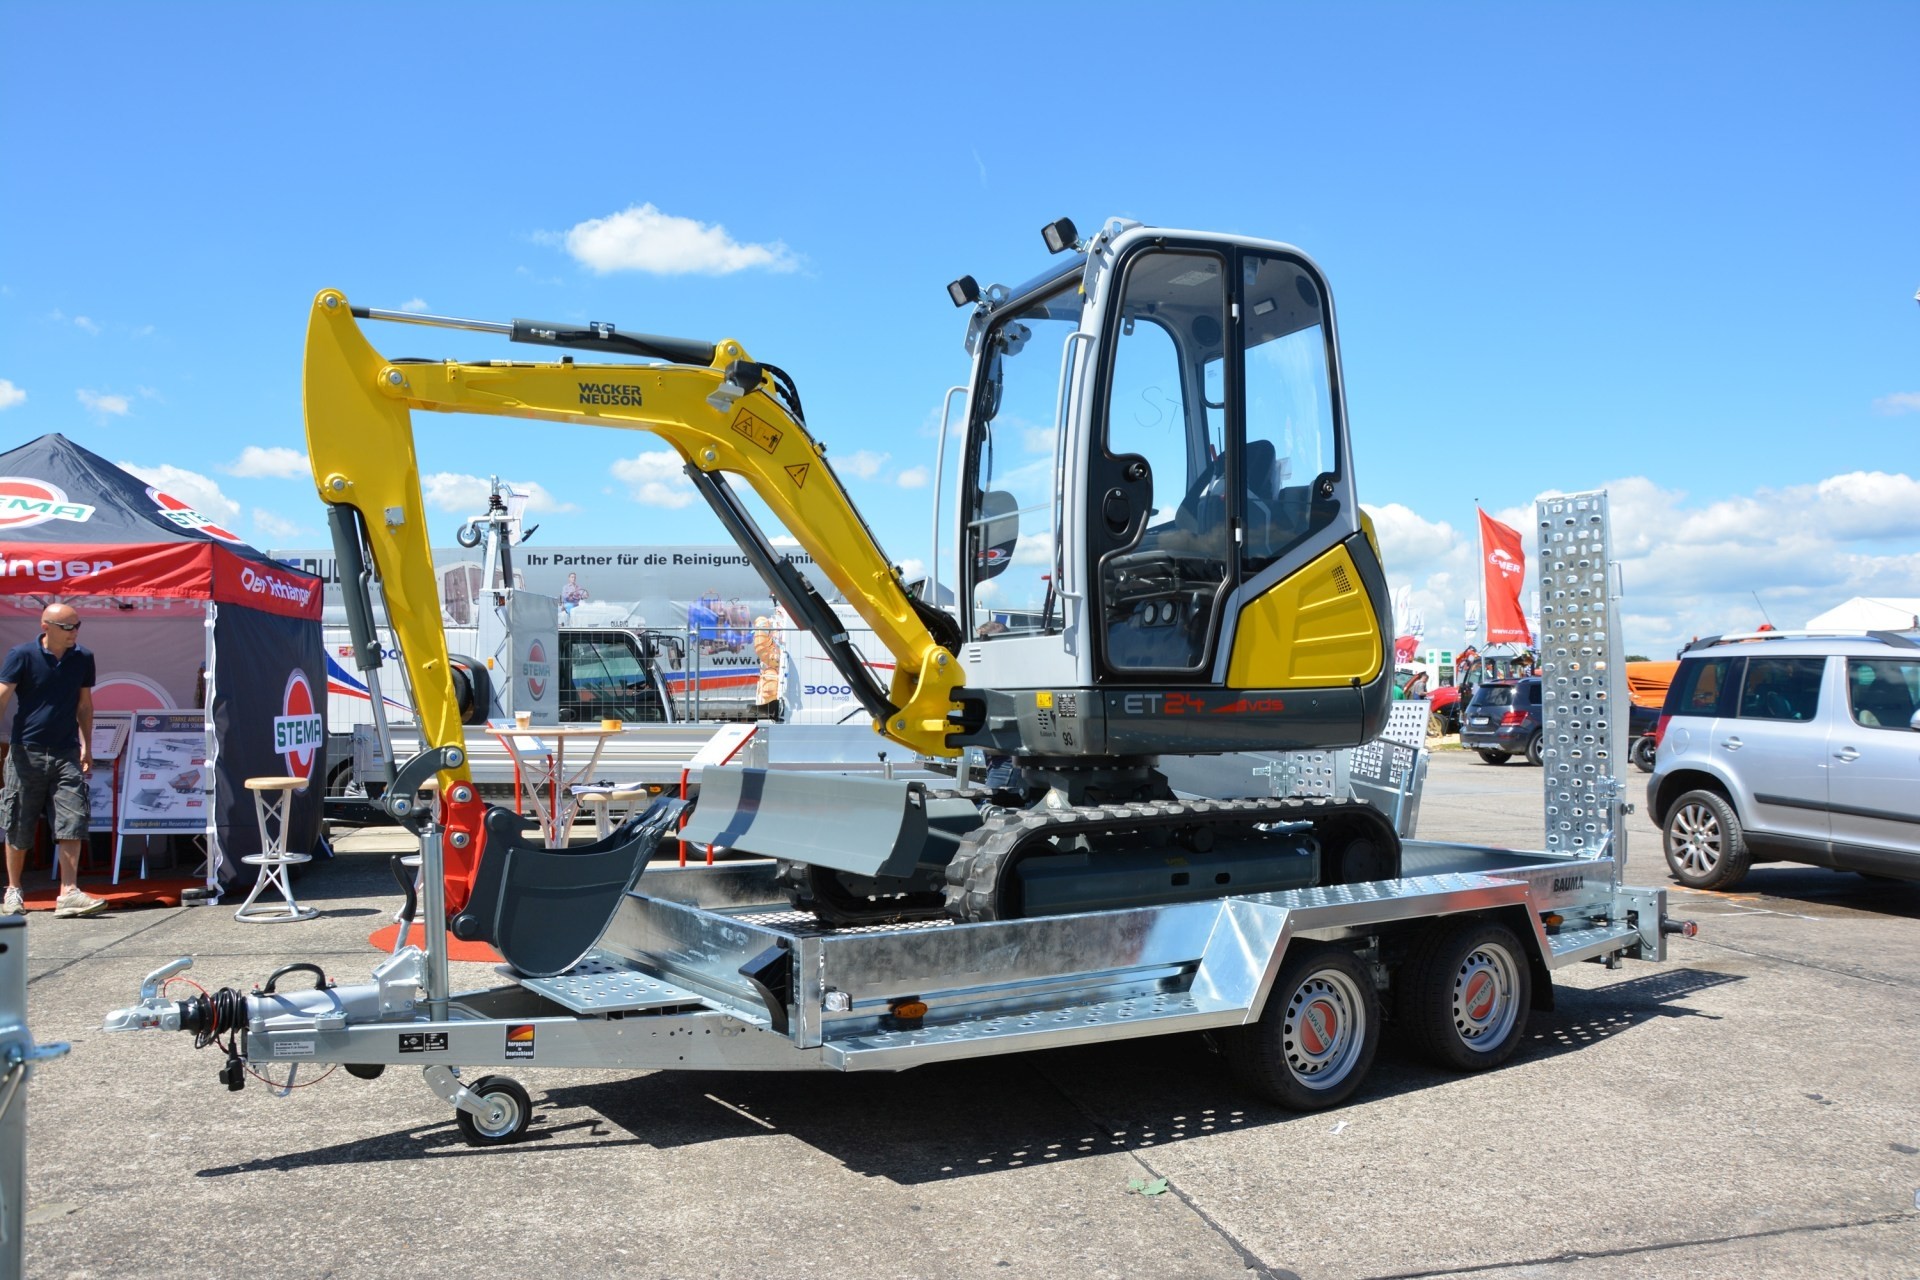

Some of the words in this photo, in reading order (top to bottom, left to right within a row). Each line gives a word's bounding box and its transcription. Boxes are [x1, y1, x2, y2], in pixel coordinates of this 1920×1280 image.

[578, 383, 641, 395] WACKER
[579, 394, 642, 406] NEUSON
[0, 498, 86, 518] MA
[527, 554, 548, 566] Ihr
[554, 554, 612, 566] Partner
[617, 553, 638, 566] für
[644, 554, 667, 565] die
[241, 567, 266, 593] Der
[523, 664, 550, 676] STEMA
[804, 685, 851, 694] 3000
[1124, 693, 1205, 714] ET24
[277, 719, 321, 747] STEMA
[1553, 876, 1584, 892] BAUMA
[1469, 980, 1492, 1010] STEMA
[1308, 1009, 1330, 1046] STEMA
